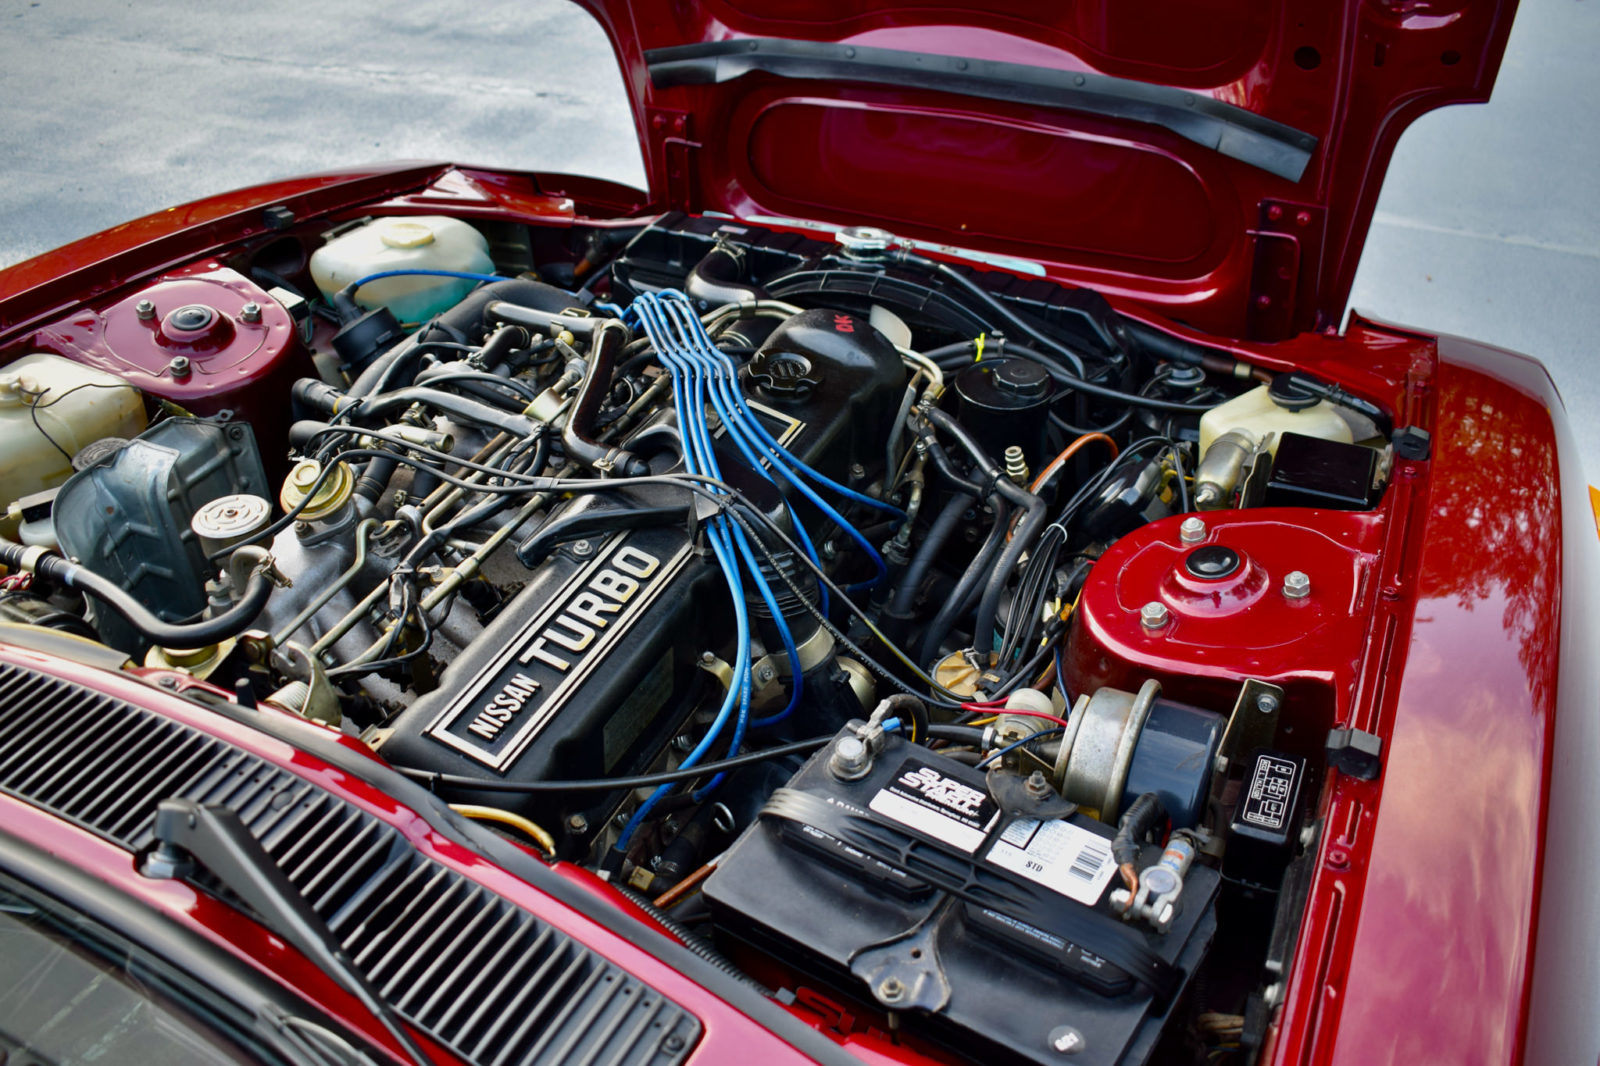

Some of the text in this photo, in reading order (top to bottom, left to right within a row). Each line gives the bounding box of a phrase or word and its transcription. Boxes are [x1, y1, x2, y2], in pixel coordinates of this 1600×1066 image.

[833, 314, 855, 333] OK
[468, 545, 660, 740] NISSAN TURBO
[898, 771, 975, 811] START
[918, 767, 987, 807] SUPER
